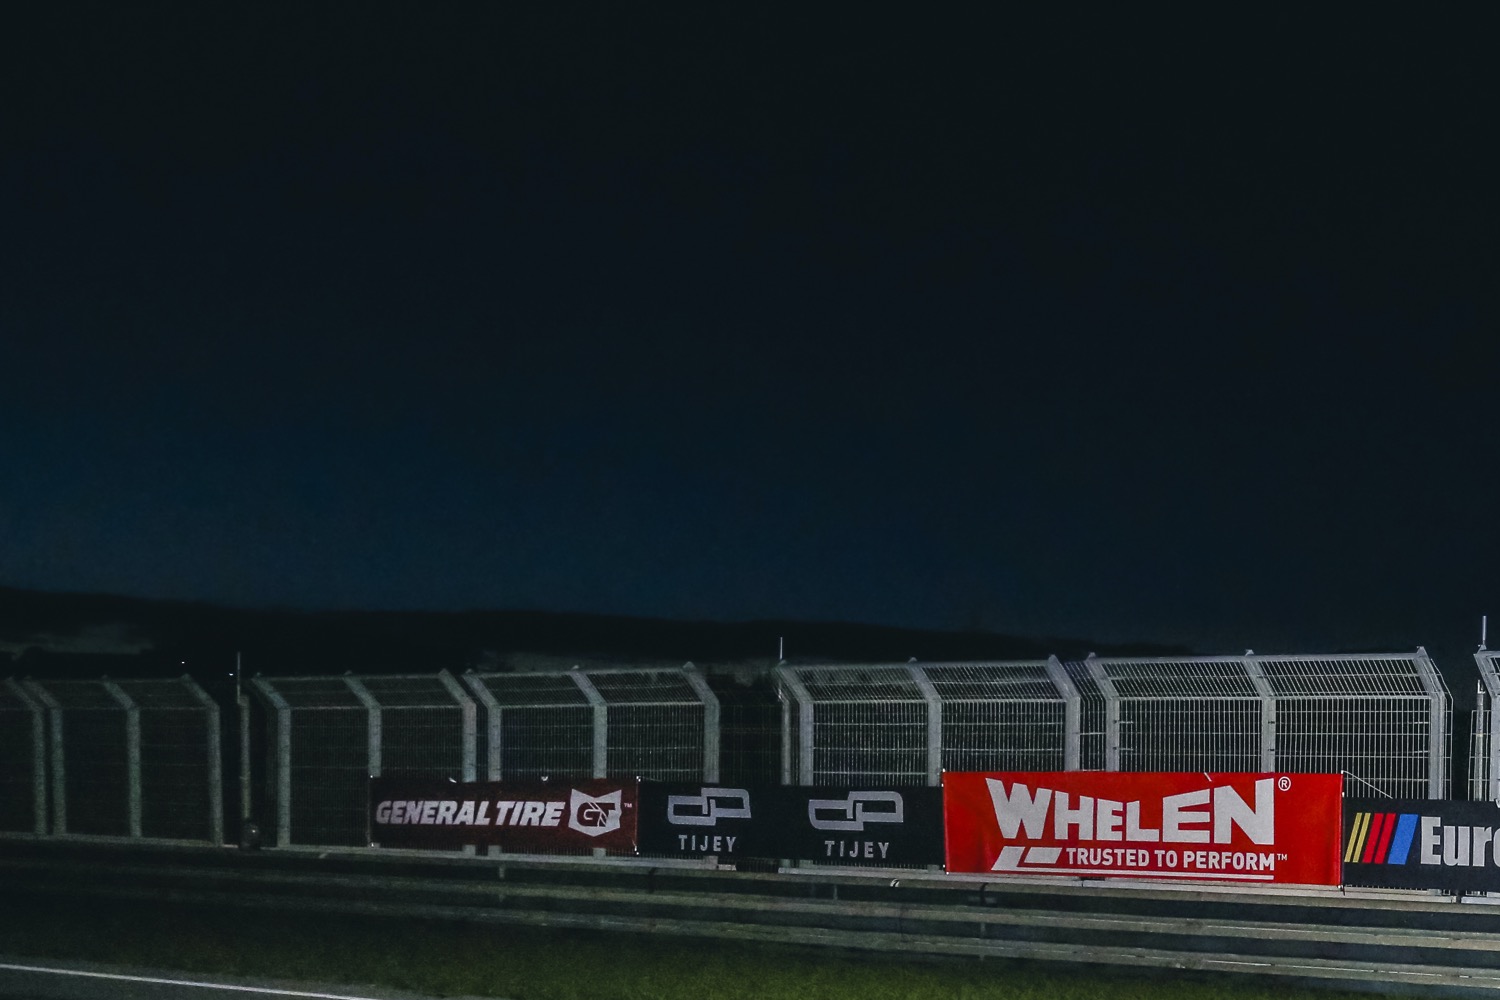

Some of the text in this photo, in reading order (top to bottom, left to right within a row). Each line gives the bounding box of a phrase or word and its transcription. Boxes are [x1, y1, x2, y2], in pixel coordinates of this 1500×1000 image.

[376, 801, 565, 827] GENERAL TIRE
[985, 777, 1275, 845] WHELEN
[678, 834, 736, 852] TIJEY
[824, 840, 889, 858] TIJEY
[1066, 848, 1275, 871] TRUSTED TO PERFORM
